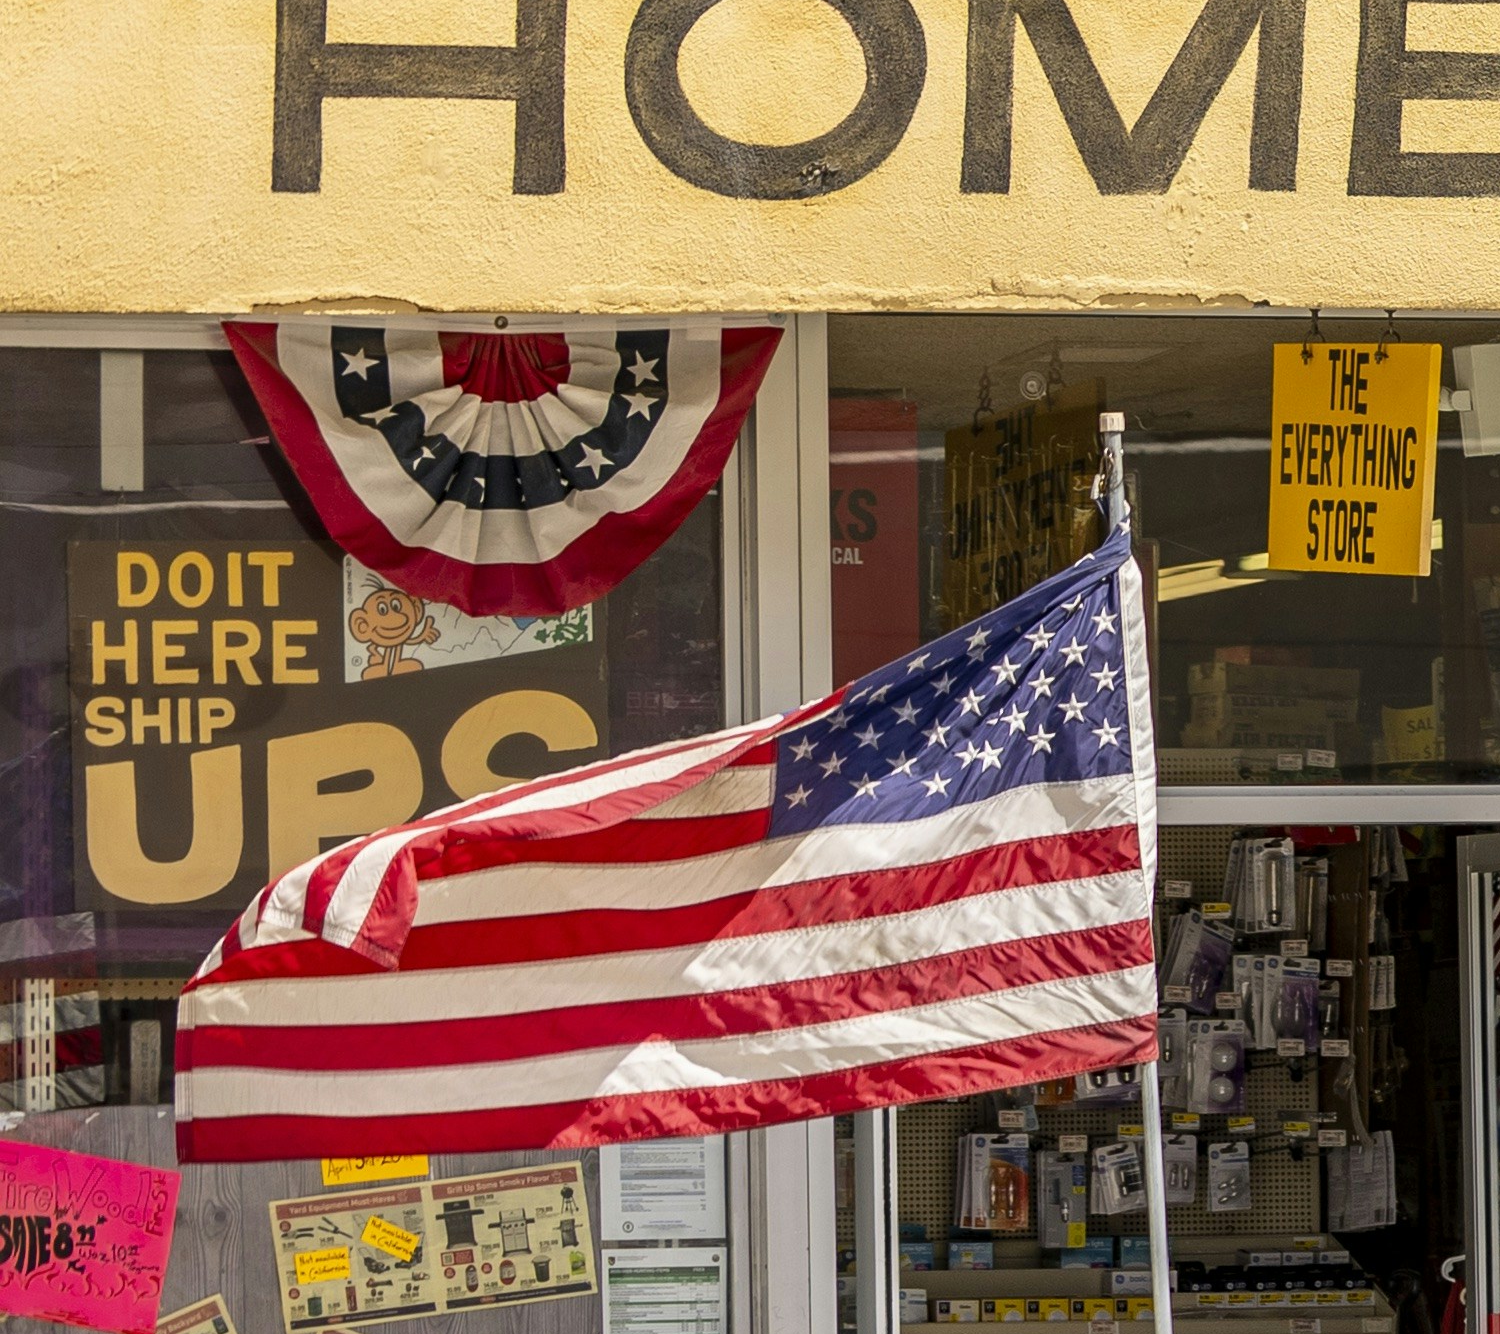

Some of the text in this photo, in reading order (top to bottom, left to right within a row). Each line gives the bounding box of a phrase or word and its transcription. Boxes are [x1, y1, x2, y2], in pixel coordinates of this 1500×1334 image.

[1328, 348, 1371, 415] THE
[1279, 423, 1419, 491] EVERYTHING
[1306, 502, 1378, 564] STORE
[91, 620, 319, 685] HERE
[84, 697, 237, 747] SHIP
